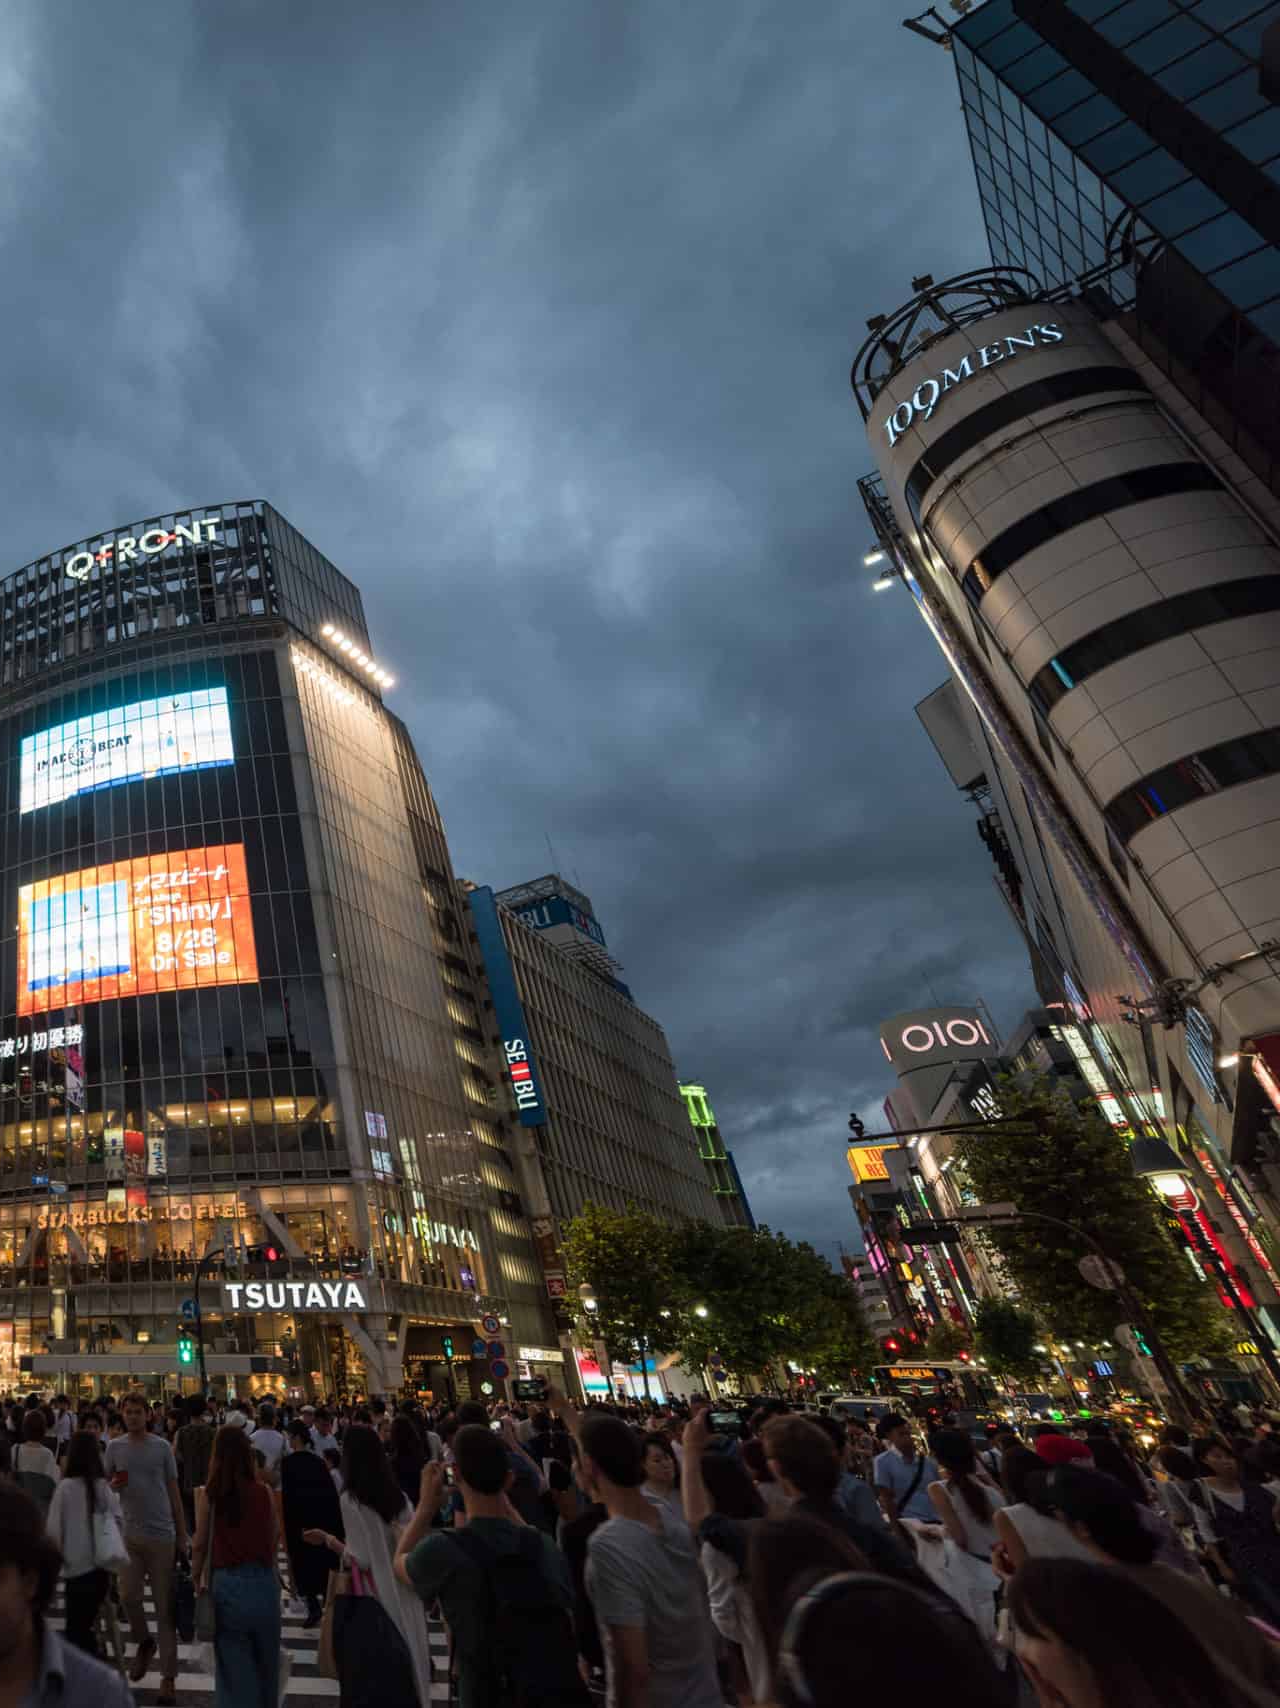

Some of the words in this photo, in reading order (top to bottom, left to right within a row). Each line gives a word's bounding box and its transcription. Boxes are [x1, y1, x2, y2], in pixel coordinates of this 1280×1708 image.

[66, 517, 221, 581] QFRONT
[155, 926, 218, 953] 8/28
[150, 953, 178, 972] On
[184, 949, 232, 967] Sale
[504, 1038, 539, 1110] SEIBU
[36, 1205, 154, 1230] STARBUCKS
[164, 1202, 248, 1221] COFFEE
[225, 1282, 366, 1309] TSUTAYA
